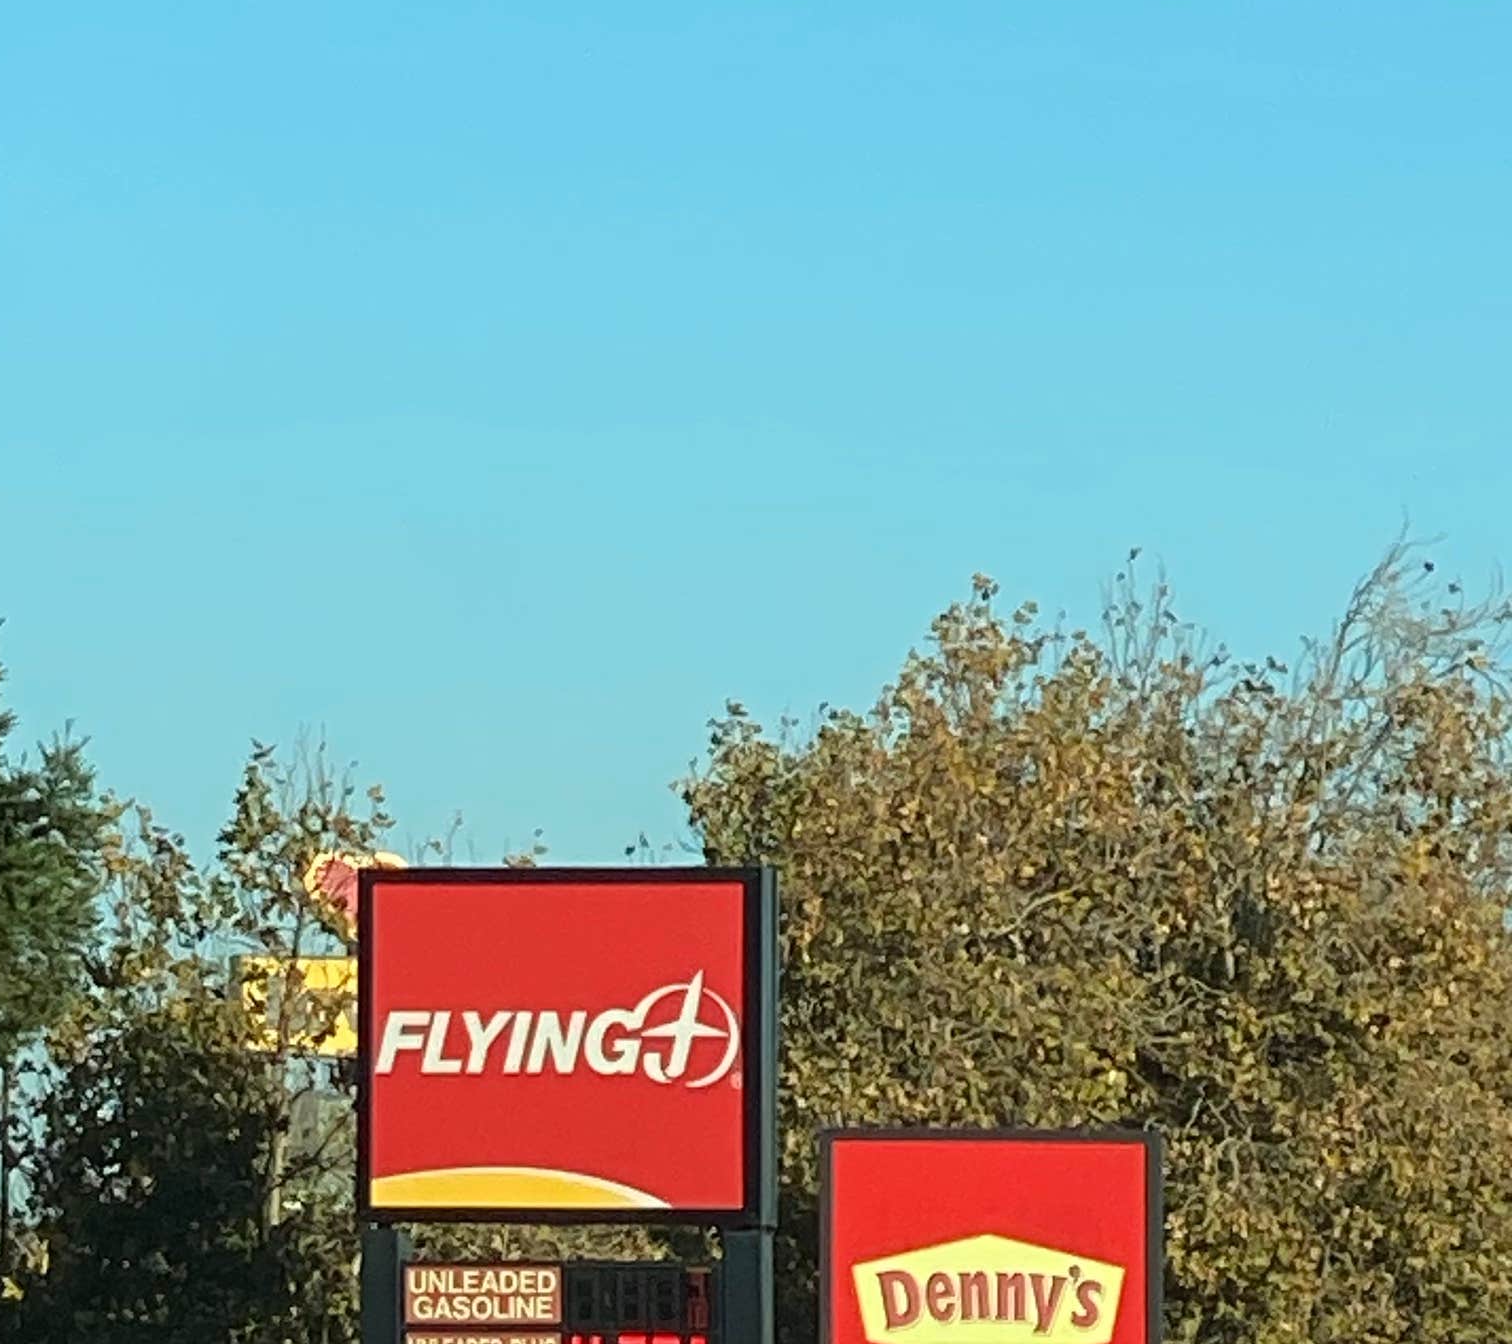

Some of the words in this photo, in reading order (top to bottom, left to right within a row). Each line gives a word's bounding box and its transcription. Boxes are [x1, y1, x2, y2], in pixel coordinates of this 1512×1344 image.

[374, 1009, 643, 1075] FLYING
[409, 1270, 556, 1294] UNLEADED
[876, 1264, 1103, 1336] Denny's
[413, 1296, 553, 1320] GASOLINE
